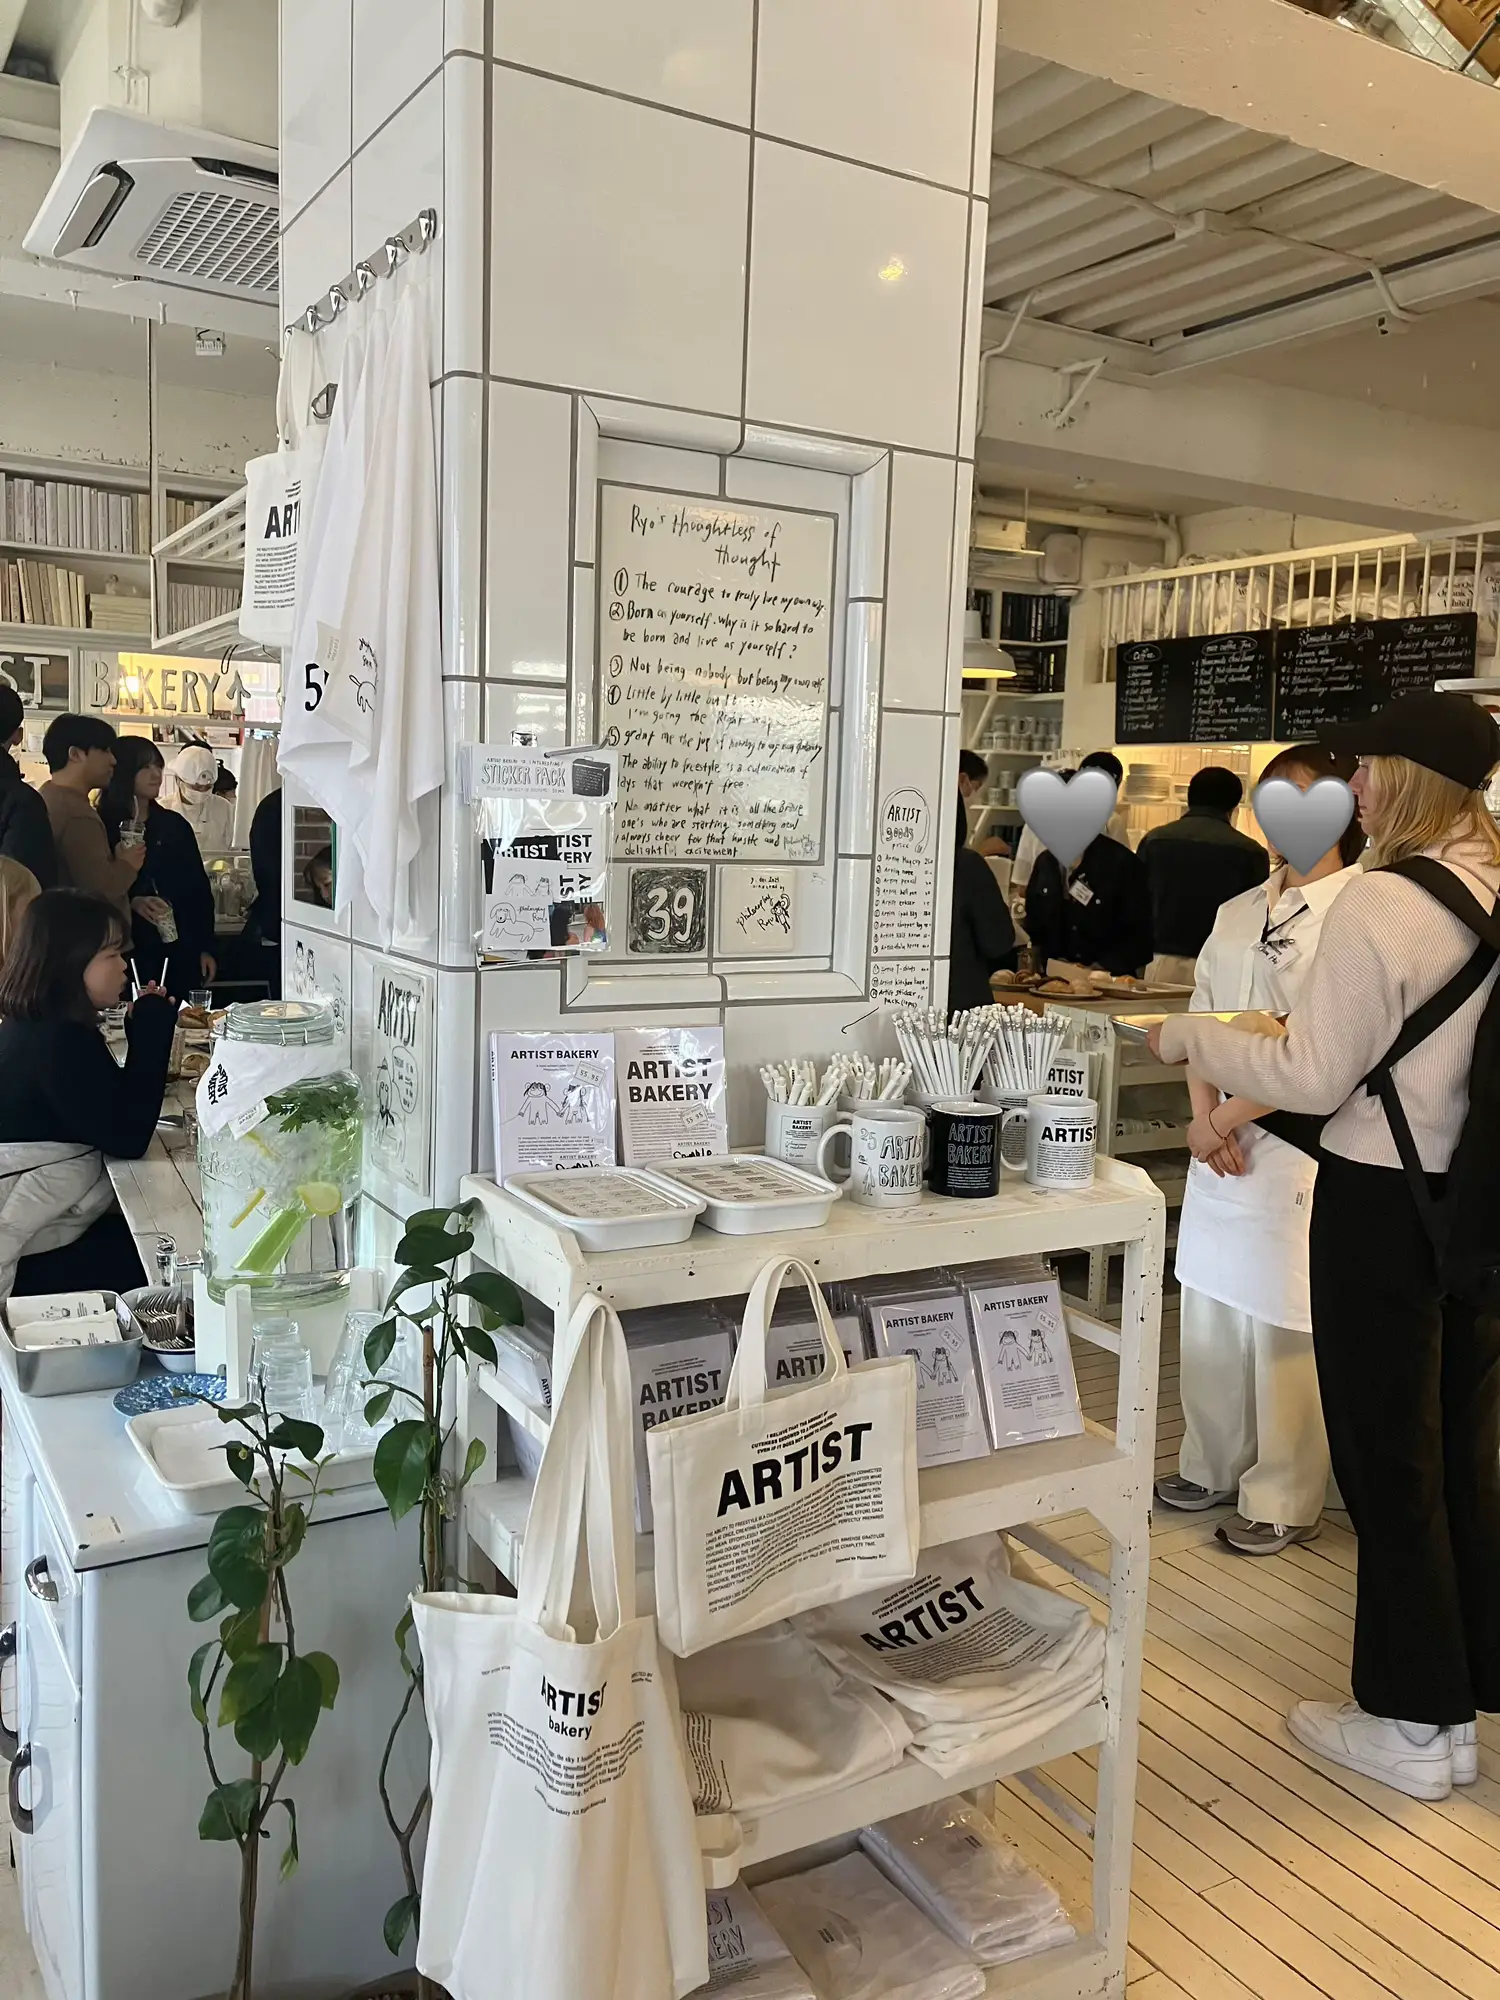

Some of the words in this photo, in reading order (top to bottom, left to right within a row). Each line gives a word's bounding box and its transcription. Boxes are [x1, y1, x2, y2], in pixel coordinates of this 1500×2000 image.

[631, 504, 666, 536] Ryo's
[672, 507, 755, 542] thoughtless
[764, 522, 782, 548] of
[715, 544, 781, 583] thought
[635, 571, 657, 591] The
[667, 582, 714, 603] courage
[735, 590, 760, 610] truly
[627, 600, 653, 620] Born
[718, 613, 738, 636] why
[740, 620, 747, 628] is
[751, 620, 760, 631] it
[764, 622, 773, 632] so
[775, 619, 800, 634] hard
[802, 624, 814, 634] to
[622, 629, 635, 642] be
[643, 628, 665, 643] born
[673, 632, 691, 645] and
[697, 636, 718, 647] live
[724, 641, 735, 650] as
[630, 656, 651, 674] Not
[658, 658, 686, 681] being
[695, 662, 731, 689] nobody
[738, 668, 754, 685] but
[756, 668, 778, 693] being
[91, 660, 221, 715] BAKERY
[660, 685, 673, 709] by
[652, 711, 681, 725] going
[690, 709, 707, 724] the
[624, 728, 655, 747] grant
[680, 733, 693, 747] the
[481, 764, 531, 785] STICKER
[535, 767, 566, 787] PACK
[622, 753, 638, 768] The
[642, 756, 667, 774] ability
[671, 758, 679, 769] to
[683, 758, 720, 776] freestyle
[737, 764, 742, 772] a
[800, 765, 809, 779] of
[644, 776, 663, 791] that
[625, 799, 638, 813] No
[644, 801, 681, 812] matter
[687, 802, 710, 818] what
[719, 806, 728, 815] it
[731, 805, 739, 815] is
[749, 802, 760, 814] all
[887, 804, 921, 823] ARTIST
[651, 817, 668, 827] who
[671, 819, 686, 829] are
[691, 818, 729, 834] starting
[781, 818, 799, 830] new
[558, 835, 592, 847] TIST
[655, 832, 681, 841] cheer
[688, 833, 702, 845] for
[705, 833, 725, 845] that
[764, 834, 780, 847] and
[647, 886, 696, 942] 39
[510, 1050, 554, 1059] ARTIST
[556, 1050, 599, 1059] BAKERY
[627, 1058, 711, 1079] ARTIST
[1048, 1068, 1084, 1084] RTIST
[628, 1083, 713, 1102] BAKERY
[949, 1123, 993, 1143] ARTIST
[1041, 1126, 1097, 1143] ARTIST
[880, 1136, 922, 1160] ARTIS
[948, 1144, 993, 1165] BAKERY
[983, 1300, 1016, 1311] ARTIST
[1017, 1295, 1048, 1306] BAKERY
[886, 1317, 919, 1328] ARTIST
[921, 1312, 954, 1323] BAKERY
[776, 1350, 852, 1381] ARTIT
[639, 1369, 721, 1405] ARTIST
[751, 1439, 777, 1449] CUTENESS
[769, 1429, 788, 1438] BELIEVE
[716, 1422, 873, 1517] ARTIST
[860, 1576, 985, 1651] ARTIST
[548, 1716, 592, 1740] bakery
[708, 1925, 745, 1960] ERY
